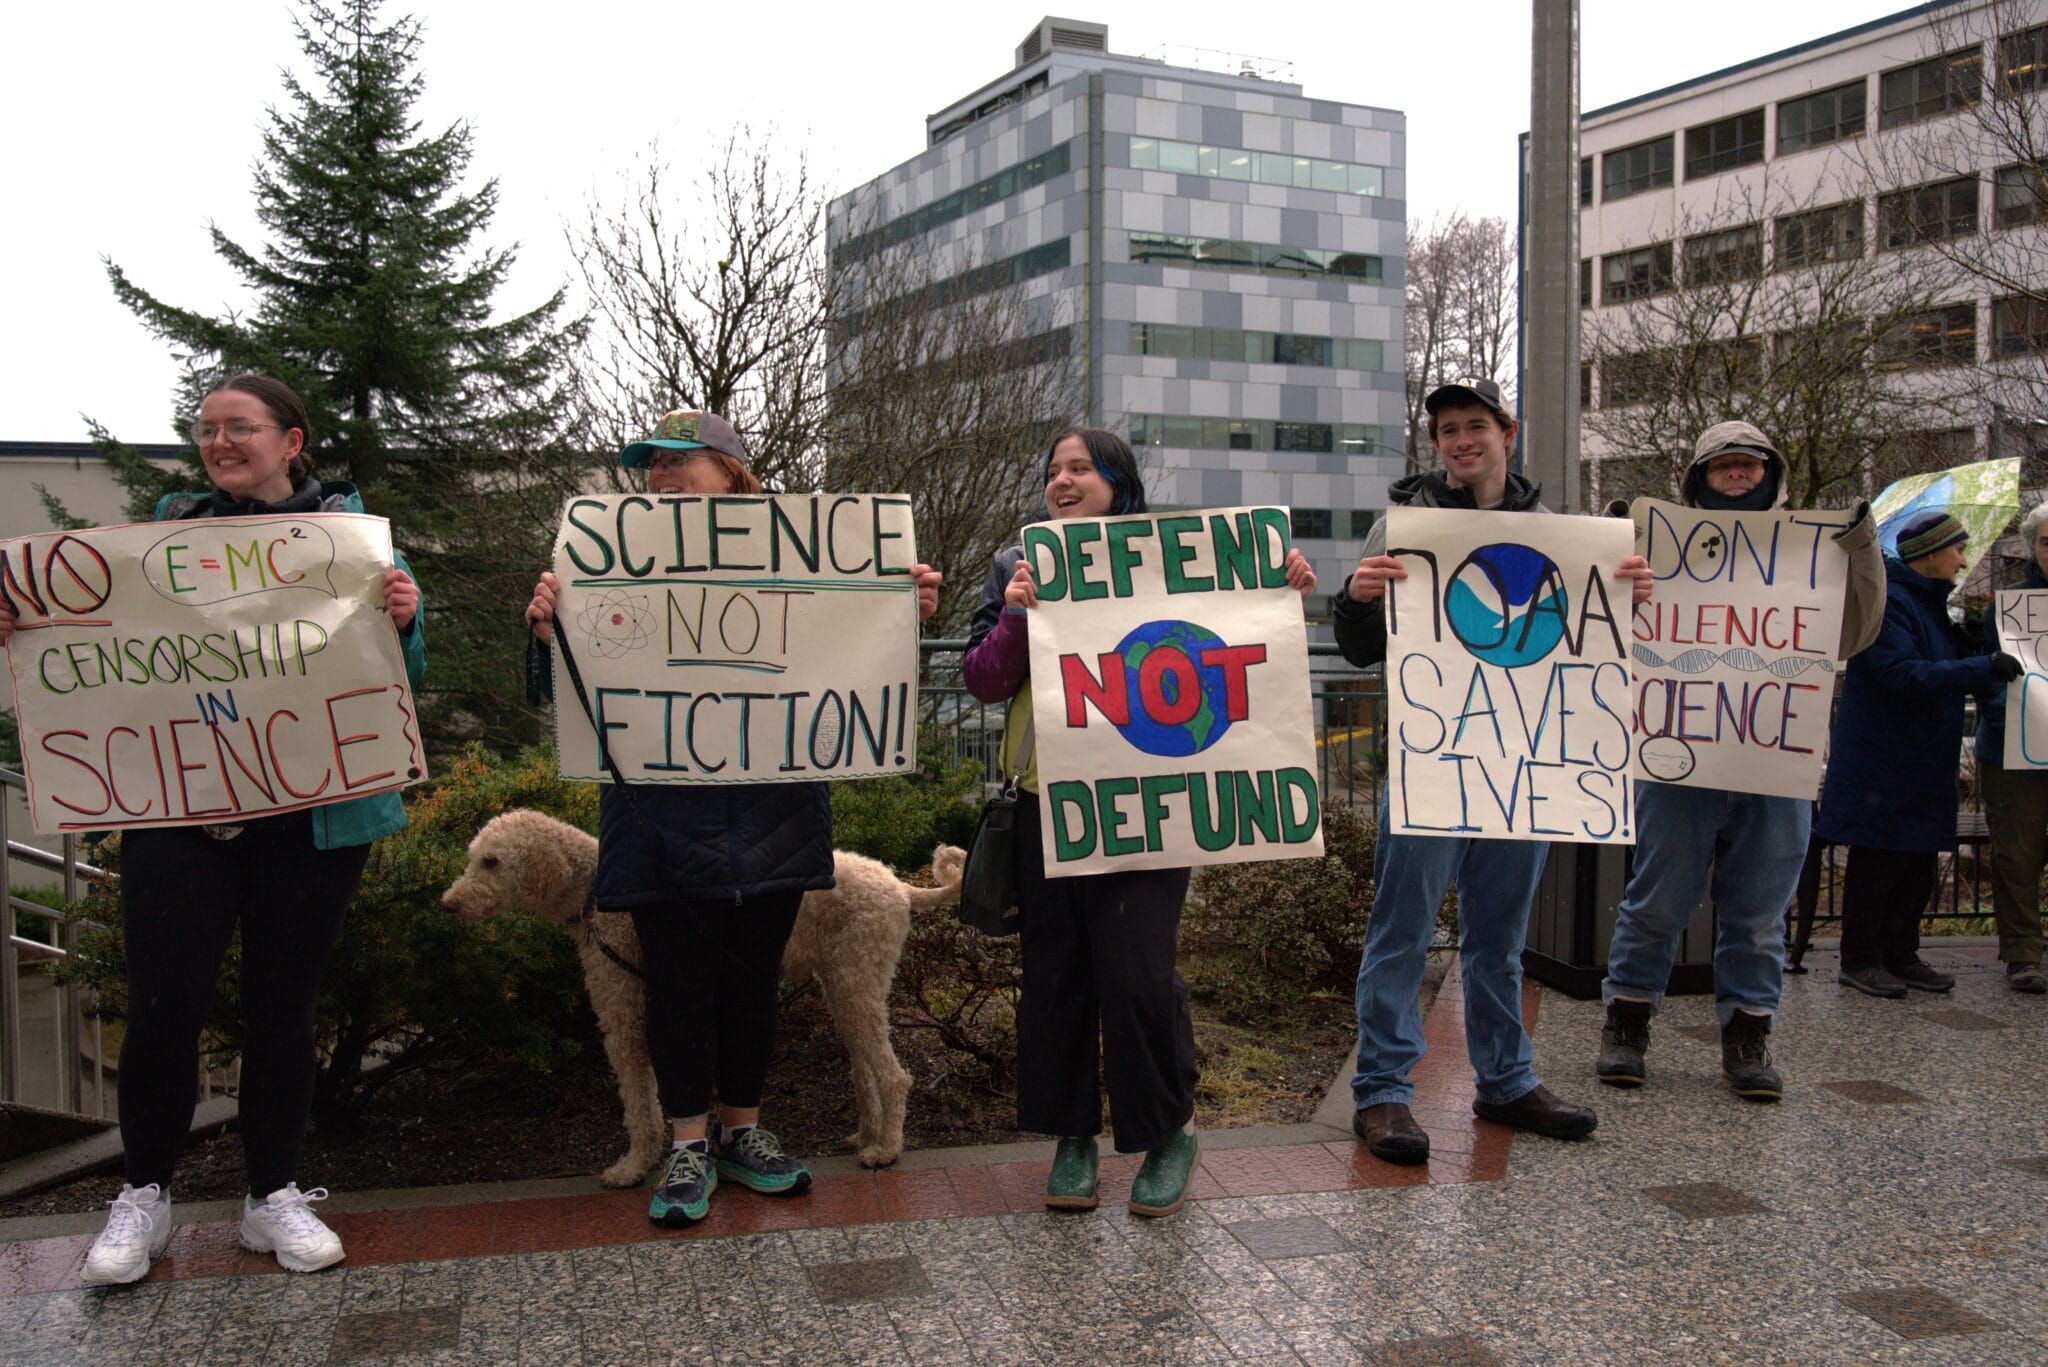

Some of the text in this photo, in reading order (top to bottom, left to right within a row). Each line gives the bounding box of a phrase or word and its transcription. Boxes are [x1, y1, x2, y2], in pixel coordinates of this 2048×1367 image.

[563, 496, 911, 577] SCIENCE
[1023, 508, 1291, 601] DEFEND
[1647, 506, 1849, 590] DON'T
[38, 619, 327, 695] CENSORSHIP
[668, 587, 815, 655] NOT
[1632, 600, 1826, 655] SILENCE
[195, 688, 239, 725] IN
[1059, 643, 1267, 728] NOT
[1399, 653, 1630, 771] SAVES
[595, 682, 908, 774] FICTION!
[1047, 766, 1320, 862] DEFUND
[1401, 749, 1631, 840] LIVES!
